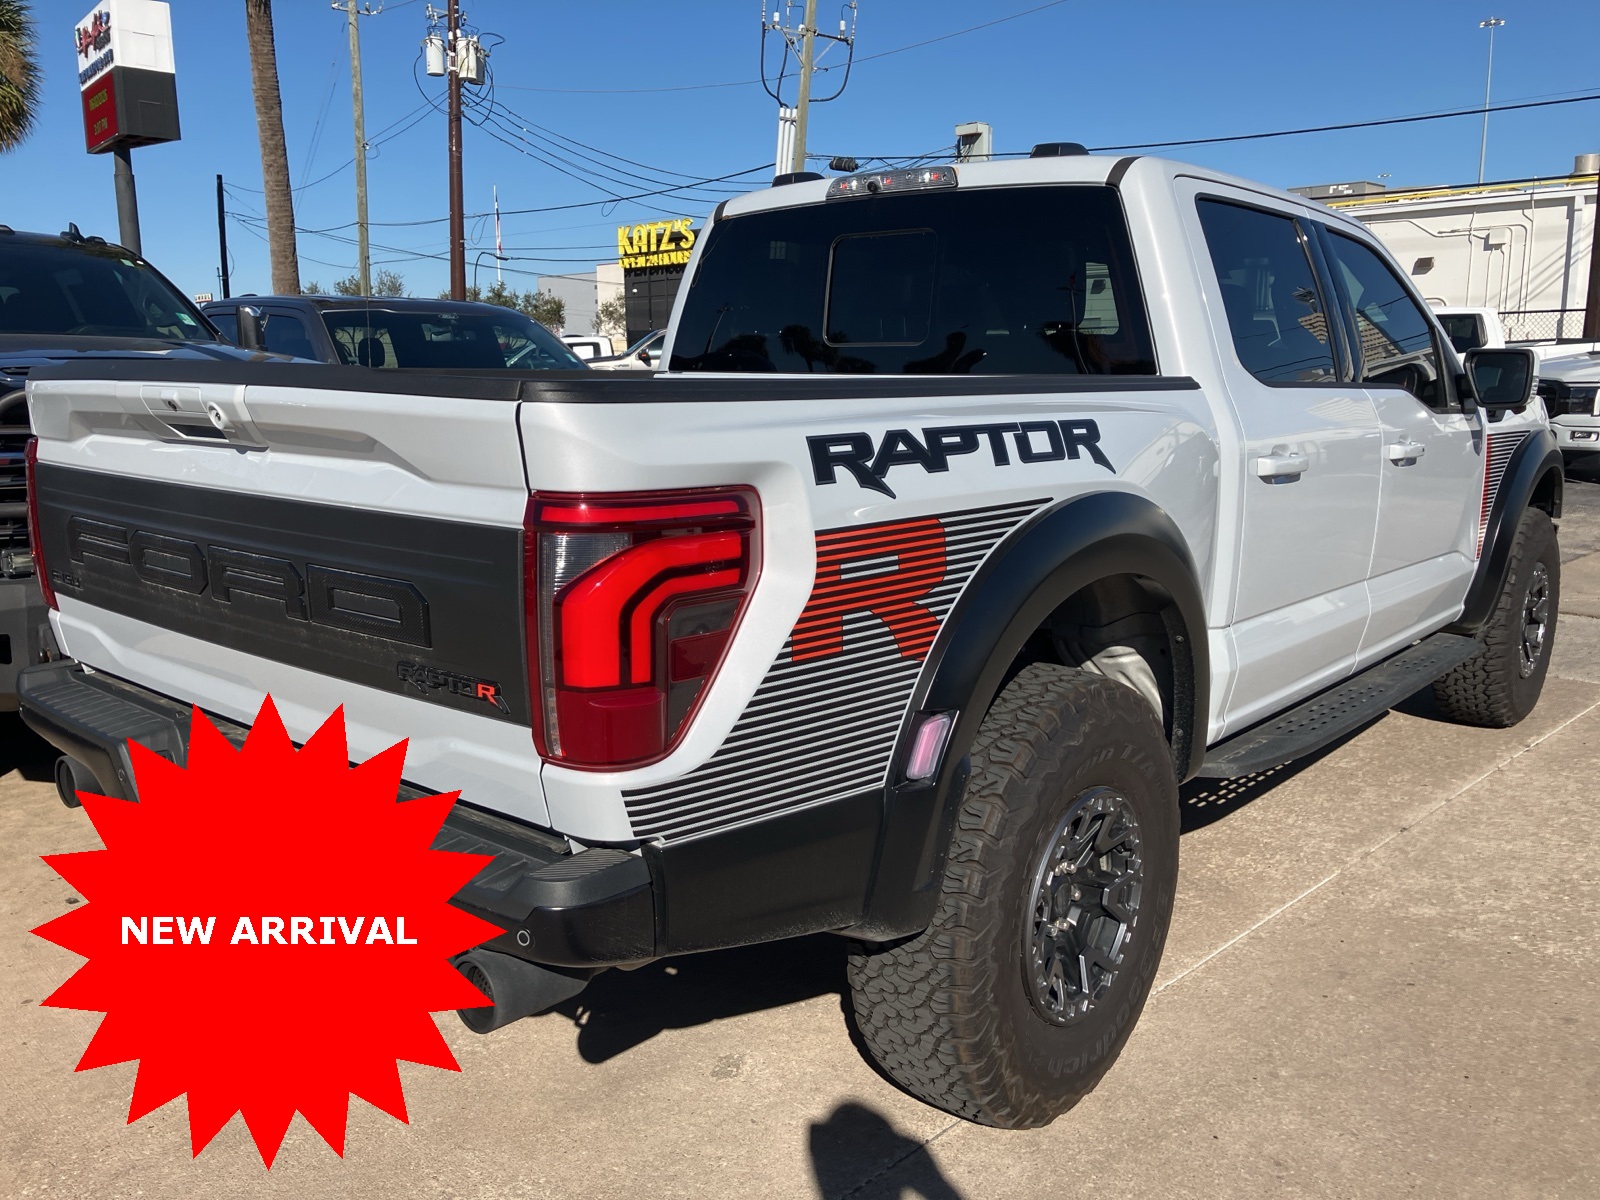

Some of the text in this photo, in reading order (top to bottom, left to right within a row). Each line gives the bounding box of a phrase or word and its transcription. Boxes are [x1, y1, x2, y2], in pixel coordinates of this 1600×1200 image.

[618, 218, 695, 254] KATZ'S
[619, 250, 693, 269] OPEN 24 HOURS
[806, 419, 1116, 499] RAPTOR
[66, 515, 432, 649] FORD
[397, 660, 511, 714] RAPTOR
